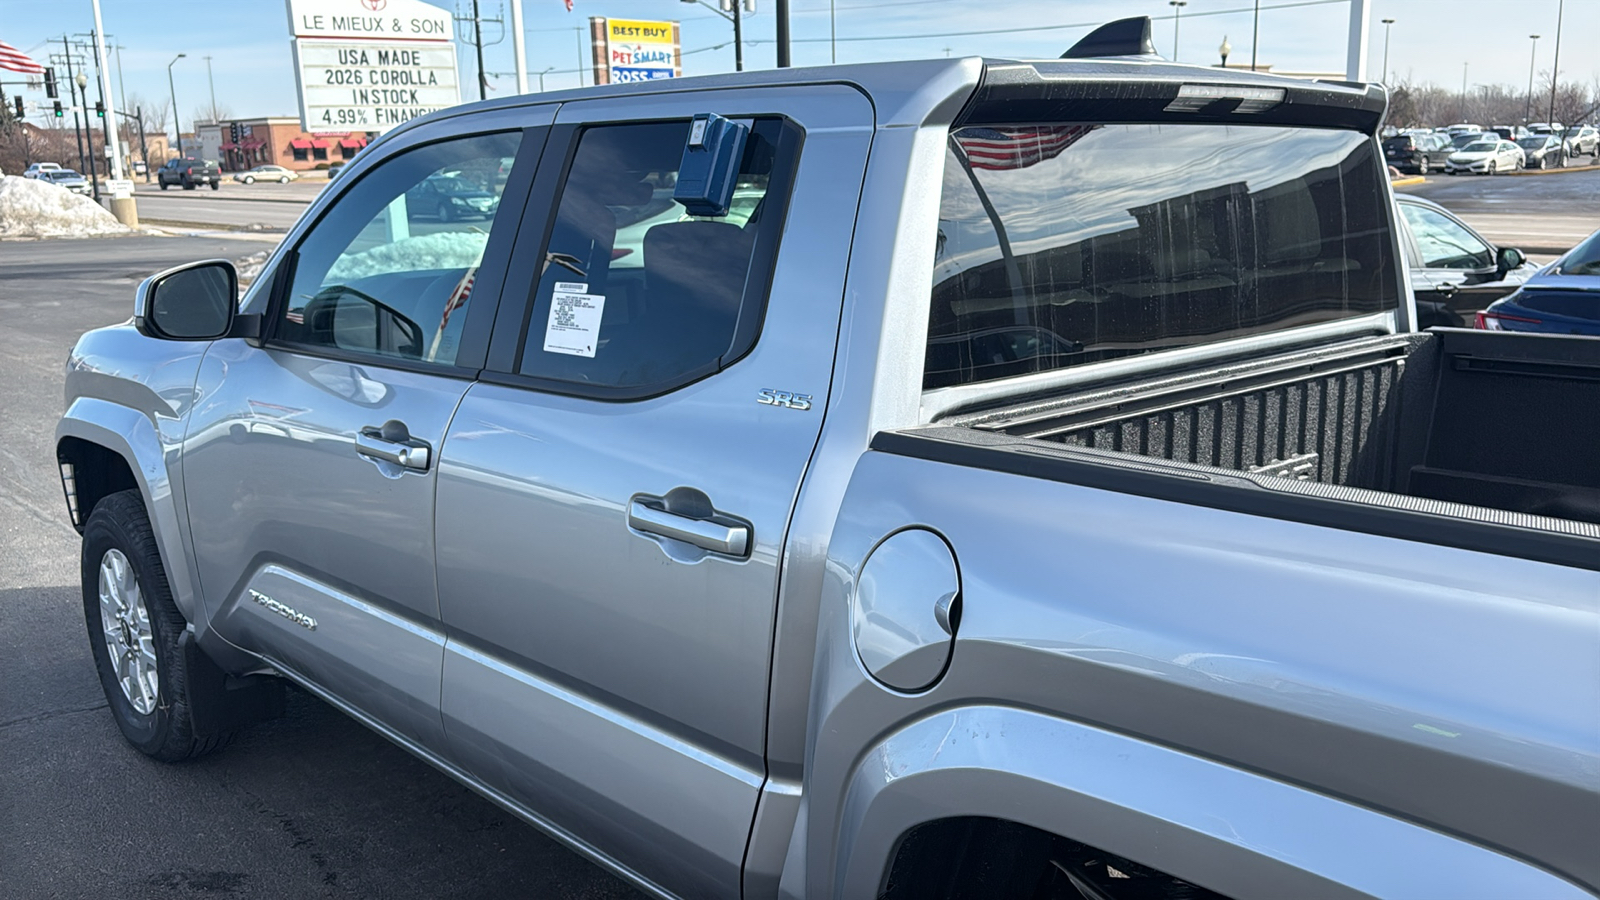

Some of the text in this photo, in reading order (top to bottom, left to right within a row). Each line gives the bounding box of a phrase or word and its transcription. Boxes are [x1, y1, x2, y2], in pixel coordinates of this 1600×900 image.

[303, 15, 445, 34] LE MIEUX & SON
[613, 27, 667, 37] BEST BUY
[338, 49, 421, 66] USA MADE
[325, 69, 438, 86] 2026 COROLLA
[612, 70, 649, 84] ROSS
[322, 109, 368, 125] 4.99%
[757, 387, 813, 411] SR5
[248, 588, 318, 631] TACOMA
